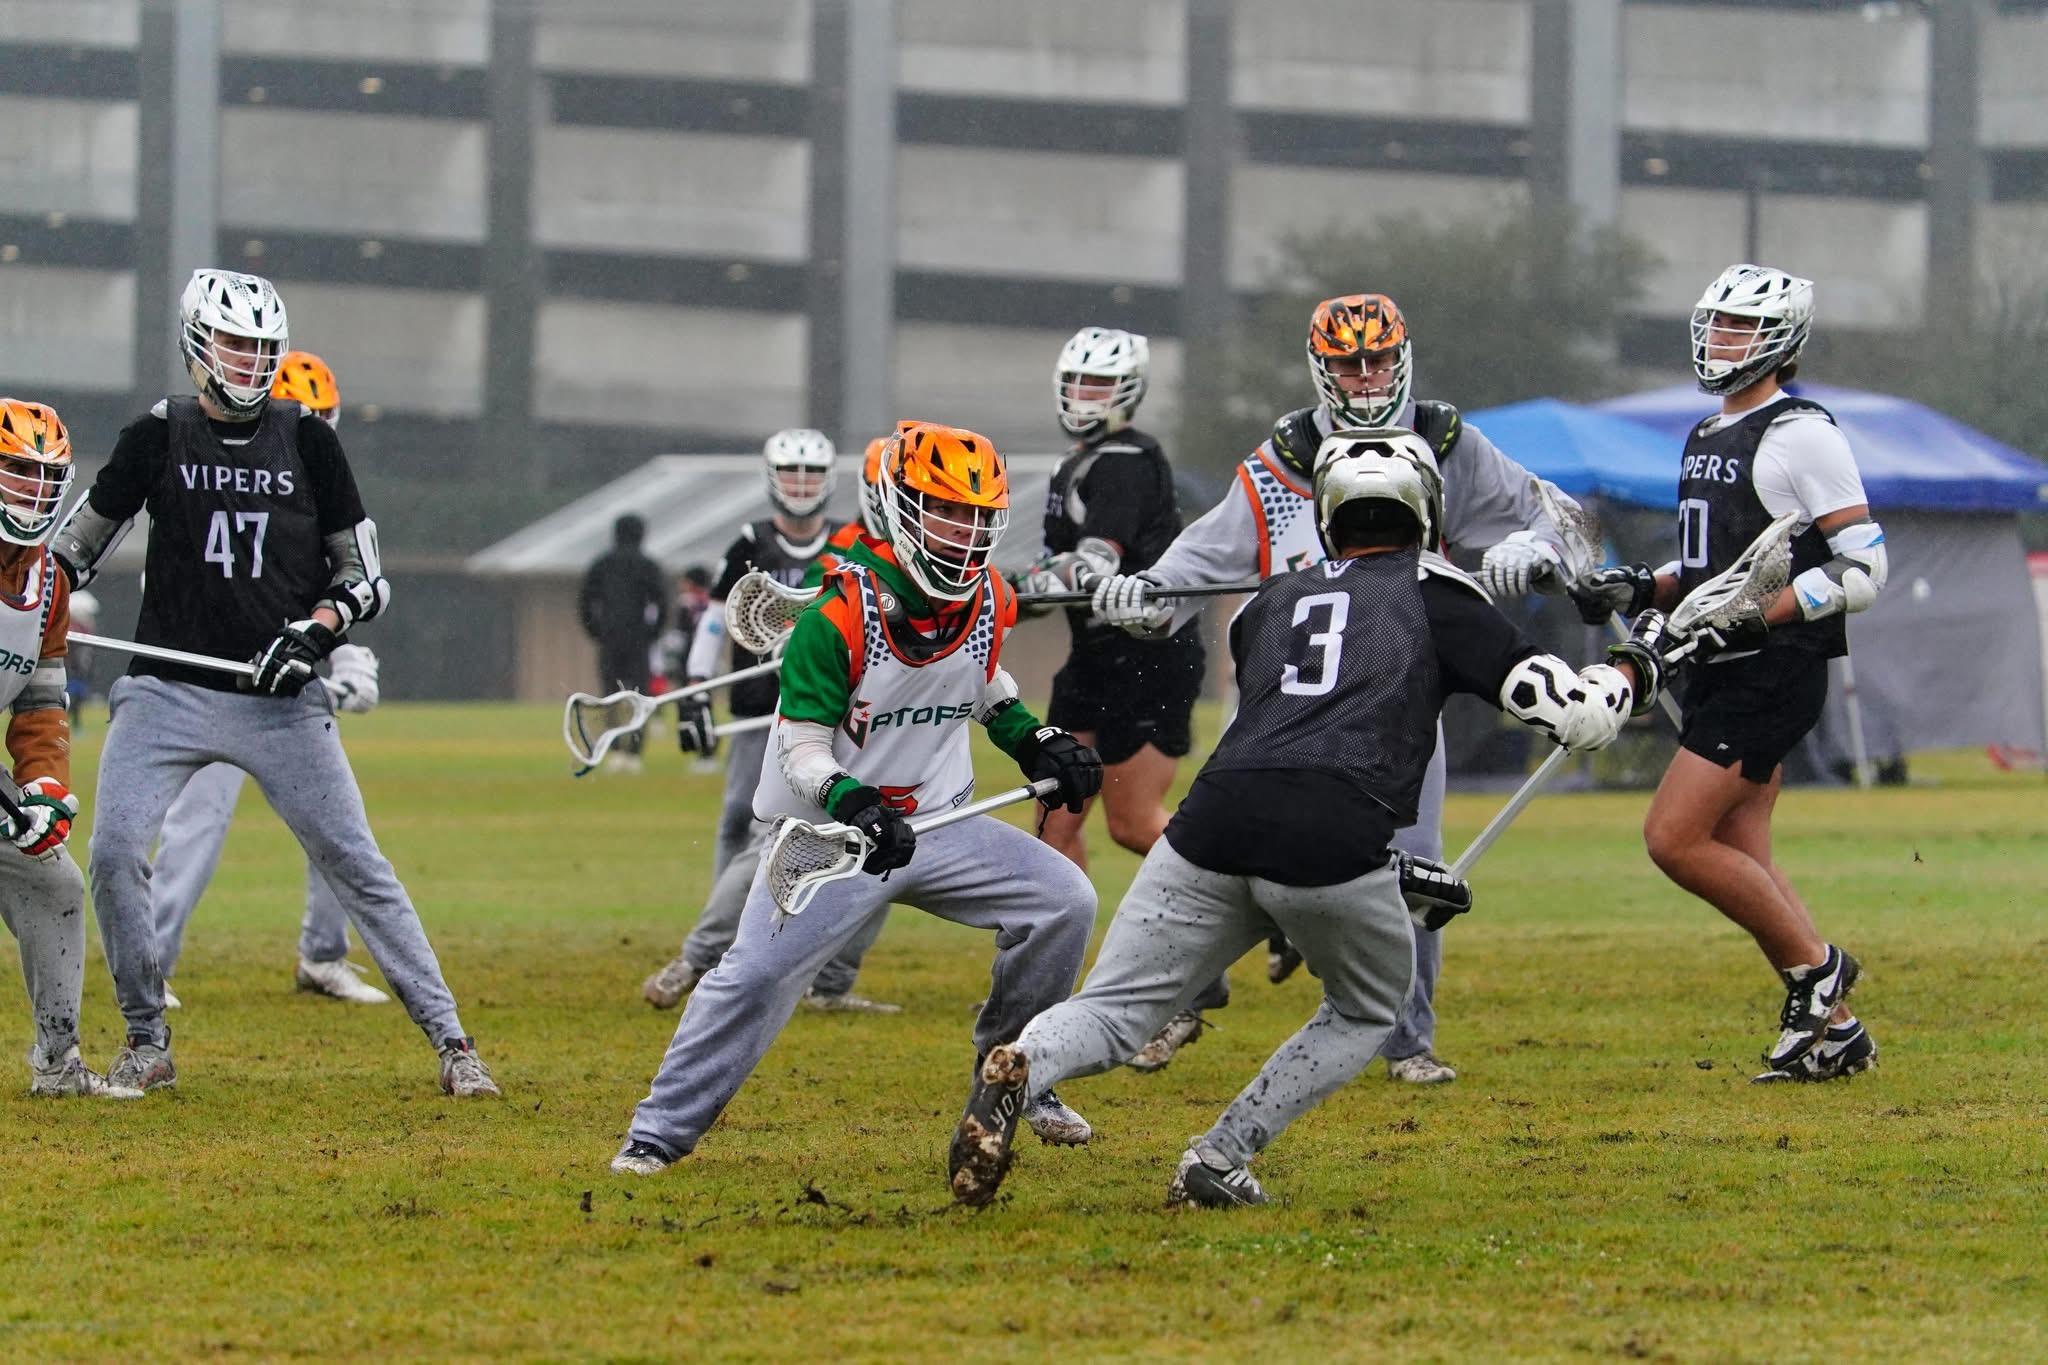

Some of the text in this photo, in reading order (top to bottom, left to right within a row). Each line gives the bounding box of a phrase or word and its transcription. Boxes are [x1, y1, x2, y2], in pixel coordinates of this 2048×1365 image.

[179, 464, 295, 495] VIPERS
[204, 510, 270, 579] 47
[1281, 591, 1350, 696] 3
[1035, 726, 1071, 743] ST
